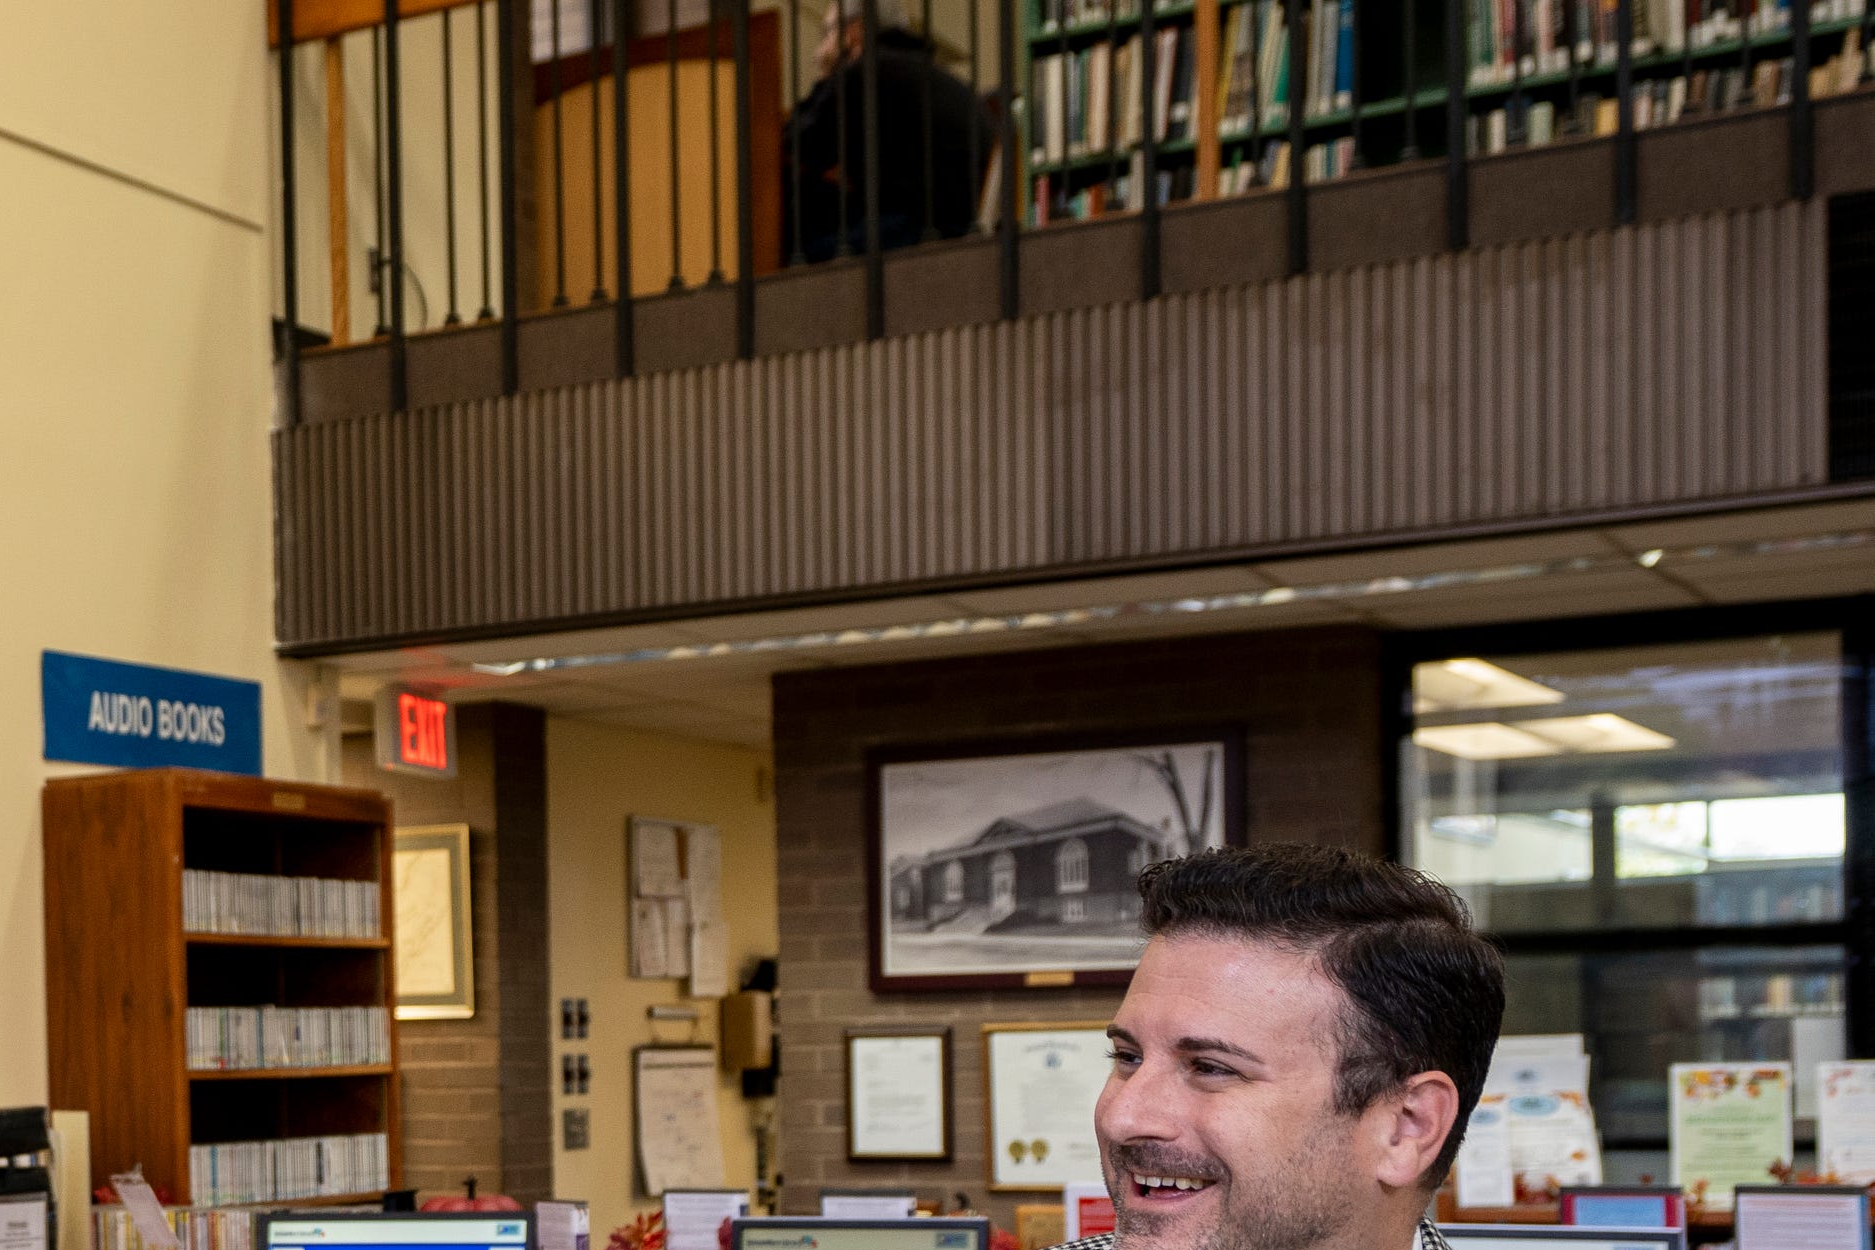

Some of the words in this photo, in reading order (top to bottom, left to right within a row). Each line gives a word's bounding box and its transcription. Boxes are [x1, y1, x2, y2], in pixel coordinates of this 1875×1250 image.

[88, 690, 154, 739] AUDIO
[157, 699, 226, 747] BOOKS
[398, 692, 447, 770] EXIT
